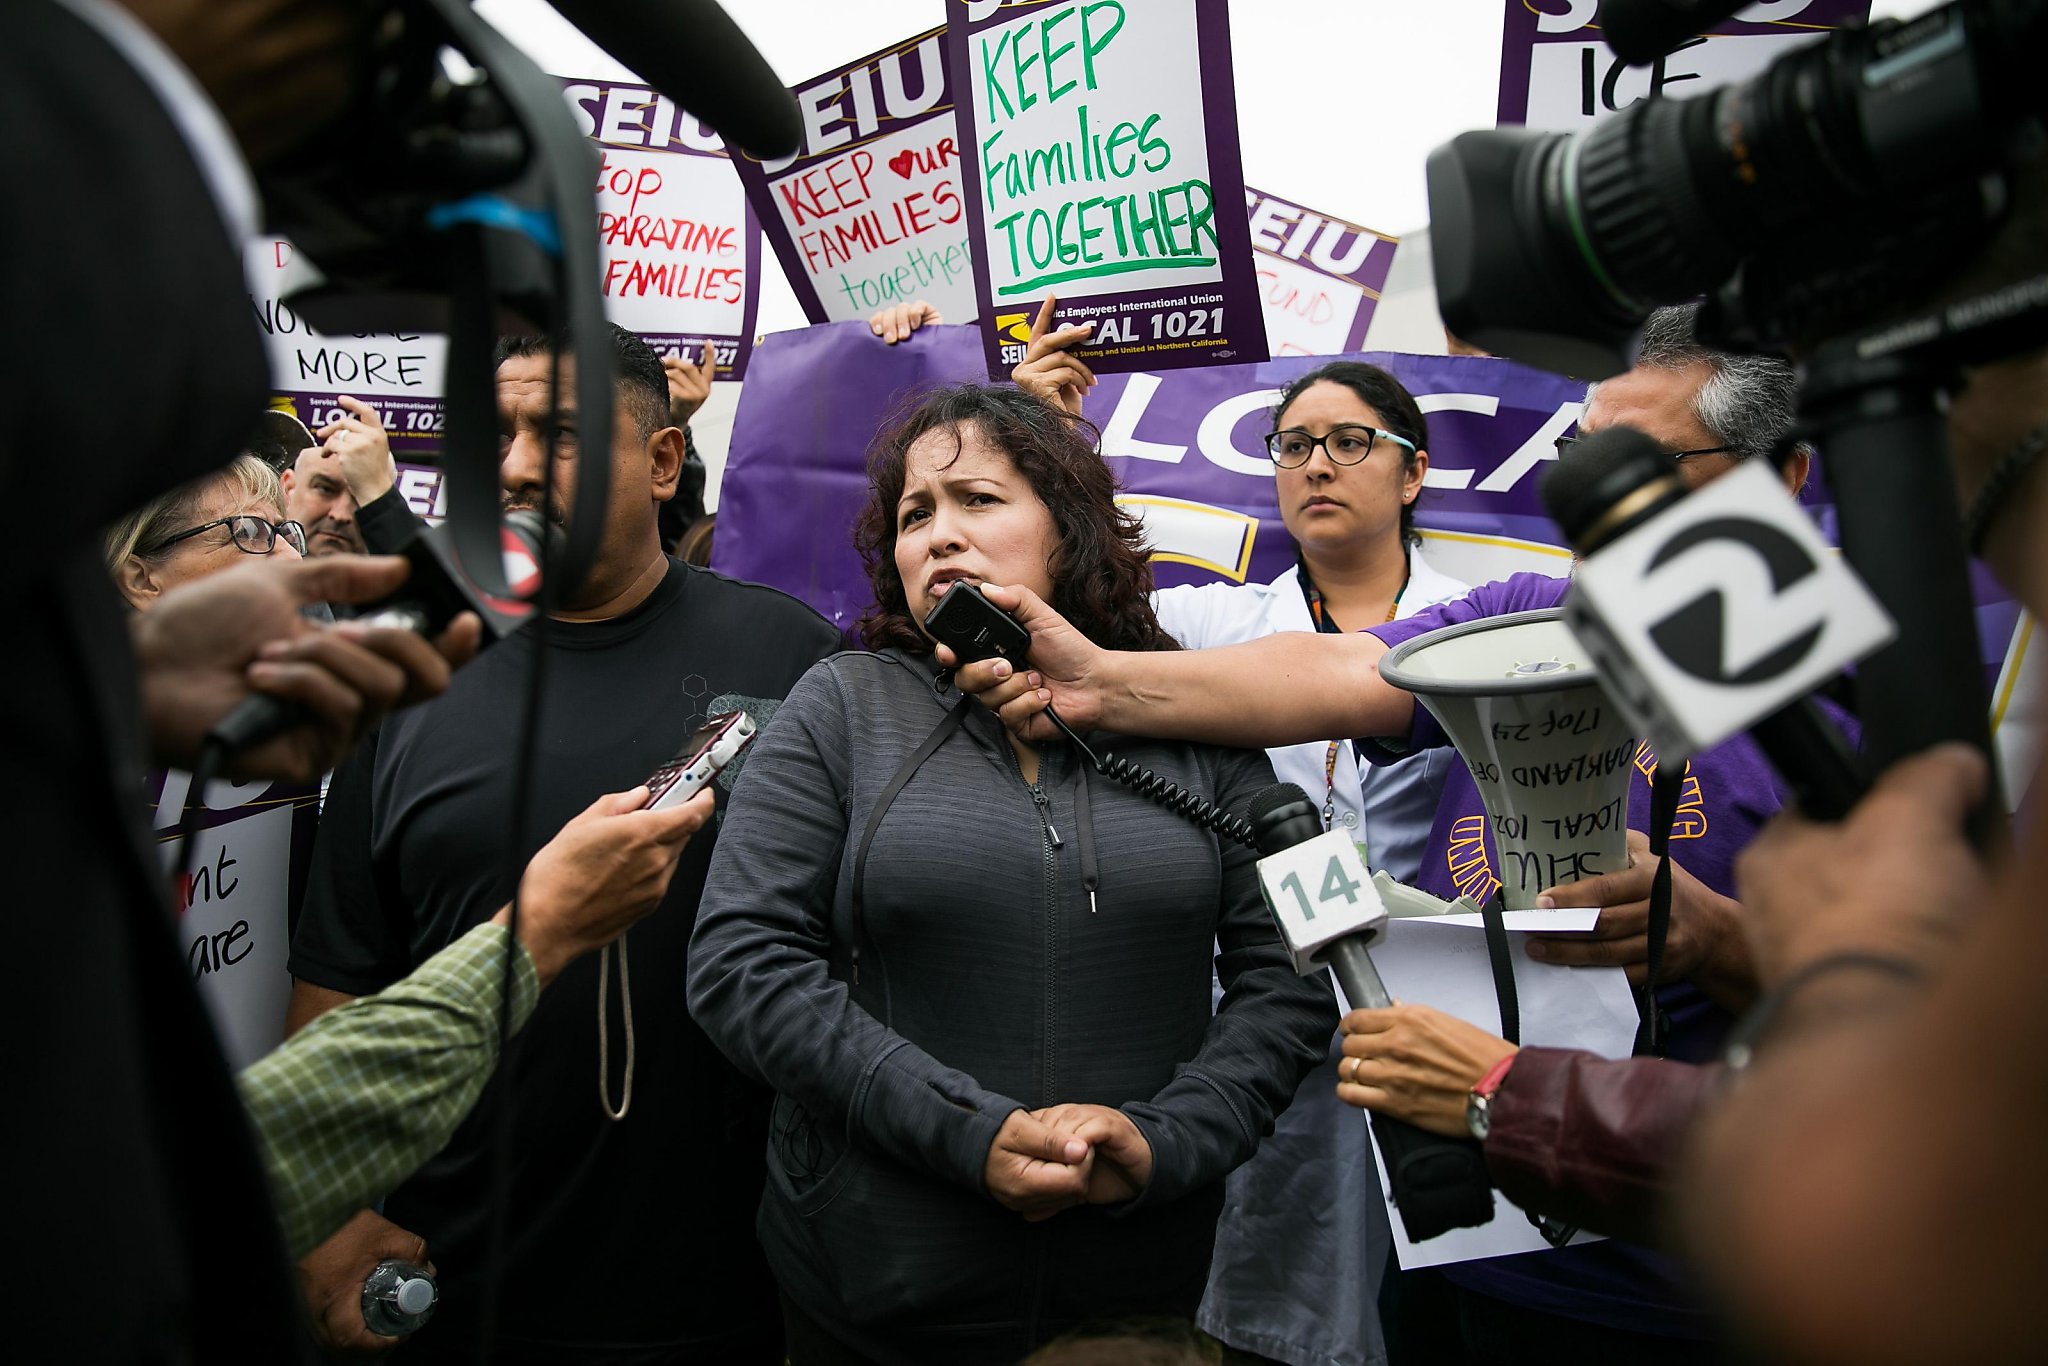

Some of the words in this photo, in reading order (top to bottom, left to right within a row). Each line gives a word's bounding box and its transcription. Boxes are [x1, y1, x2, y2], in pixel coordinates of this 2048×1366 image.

[981, 0, 1125, 124] KEEP
[761, 36, 945, 174] EIU
[596, 152, 662, 217] top
[982, 105, 1172, 213] Families
[779, 151, 873, 226] KEEP
[597, 212, 737, 257] PARATING
[799, 180, 962, 275] FAMILIES
[994, 179, 1222, 277] TOGETHER
[1246, 190, 1378, 275] EIU
[602, 259, 743, 304] FAMILIES
[839, 238, 972, 310] together
[1256, 271, 1334, 325] UND
[249, 294, 312, 335] NO
[1067, 305, 1117, 318] Employees
[1119, 296, 1187, 312] International
[1190, 294, 1224, 305] Union
[1151, 308, 1224, 339] 1021
[297, 348, 426, 385] MORE
[1080, 349, 1104, 358] Strong
[1120, 345, 1146, 354] United
[1147, 343, 1155, 351] in
[1156, 341, 1190, 351] Northern
[1191, 338, 1228, 348] California
[407, 411, 445, 430] 102
[1642, 525, 1828, 686] 2
[1512, 738, 1634, 788] OAKLAND
[1542, 797, 1620, 840] LOCAL
[1280, 854, 1362, 921] 14
[1506, 851, 1604, 894] SEIU
